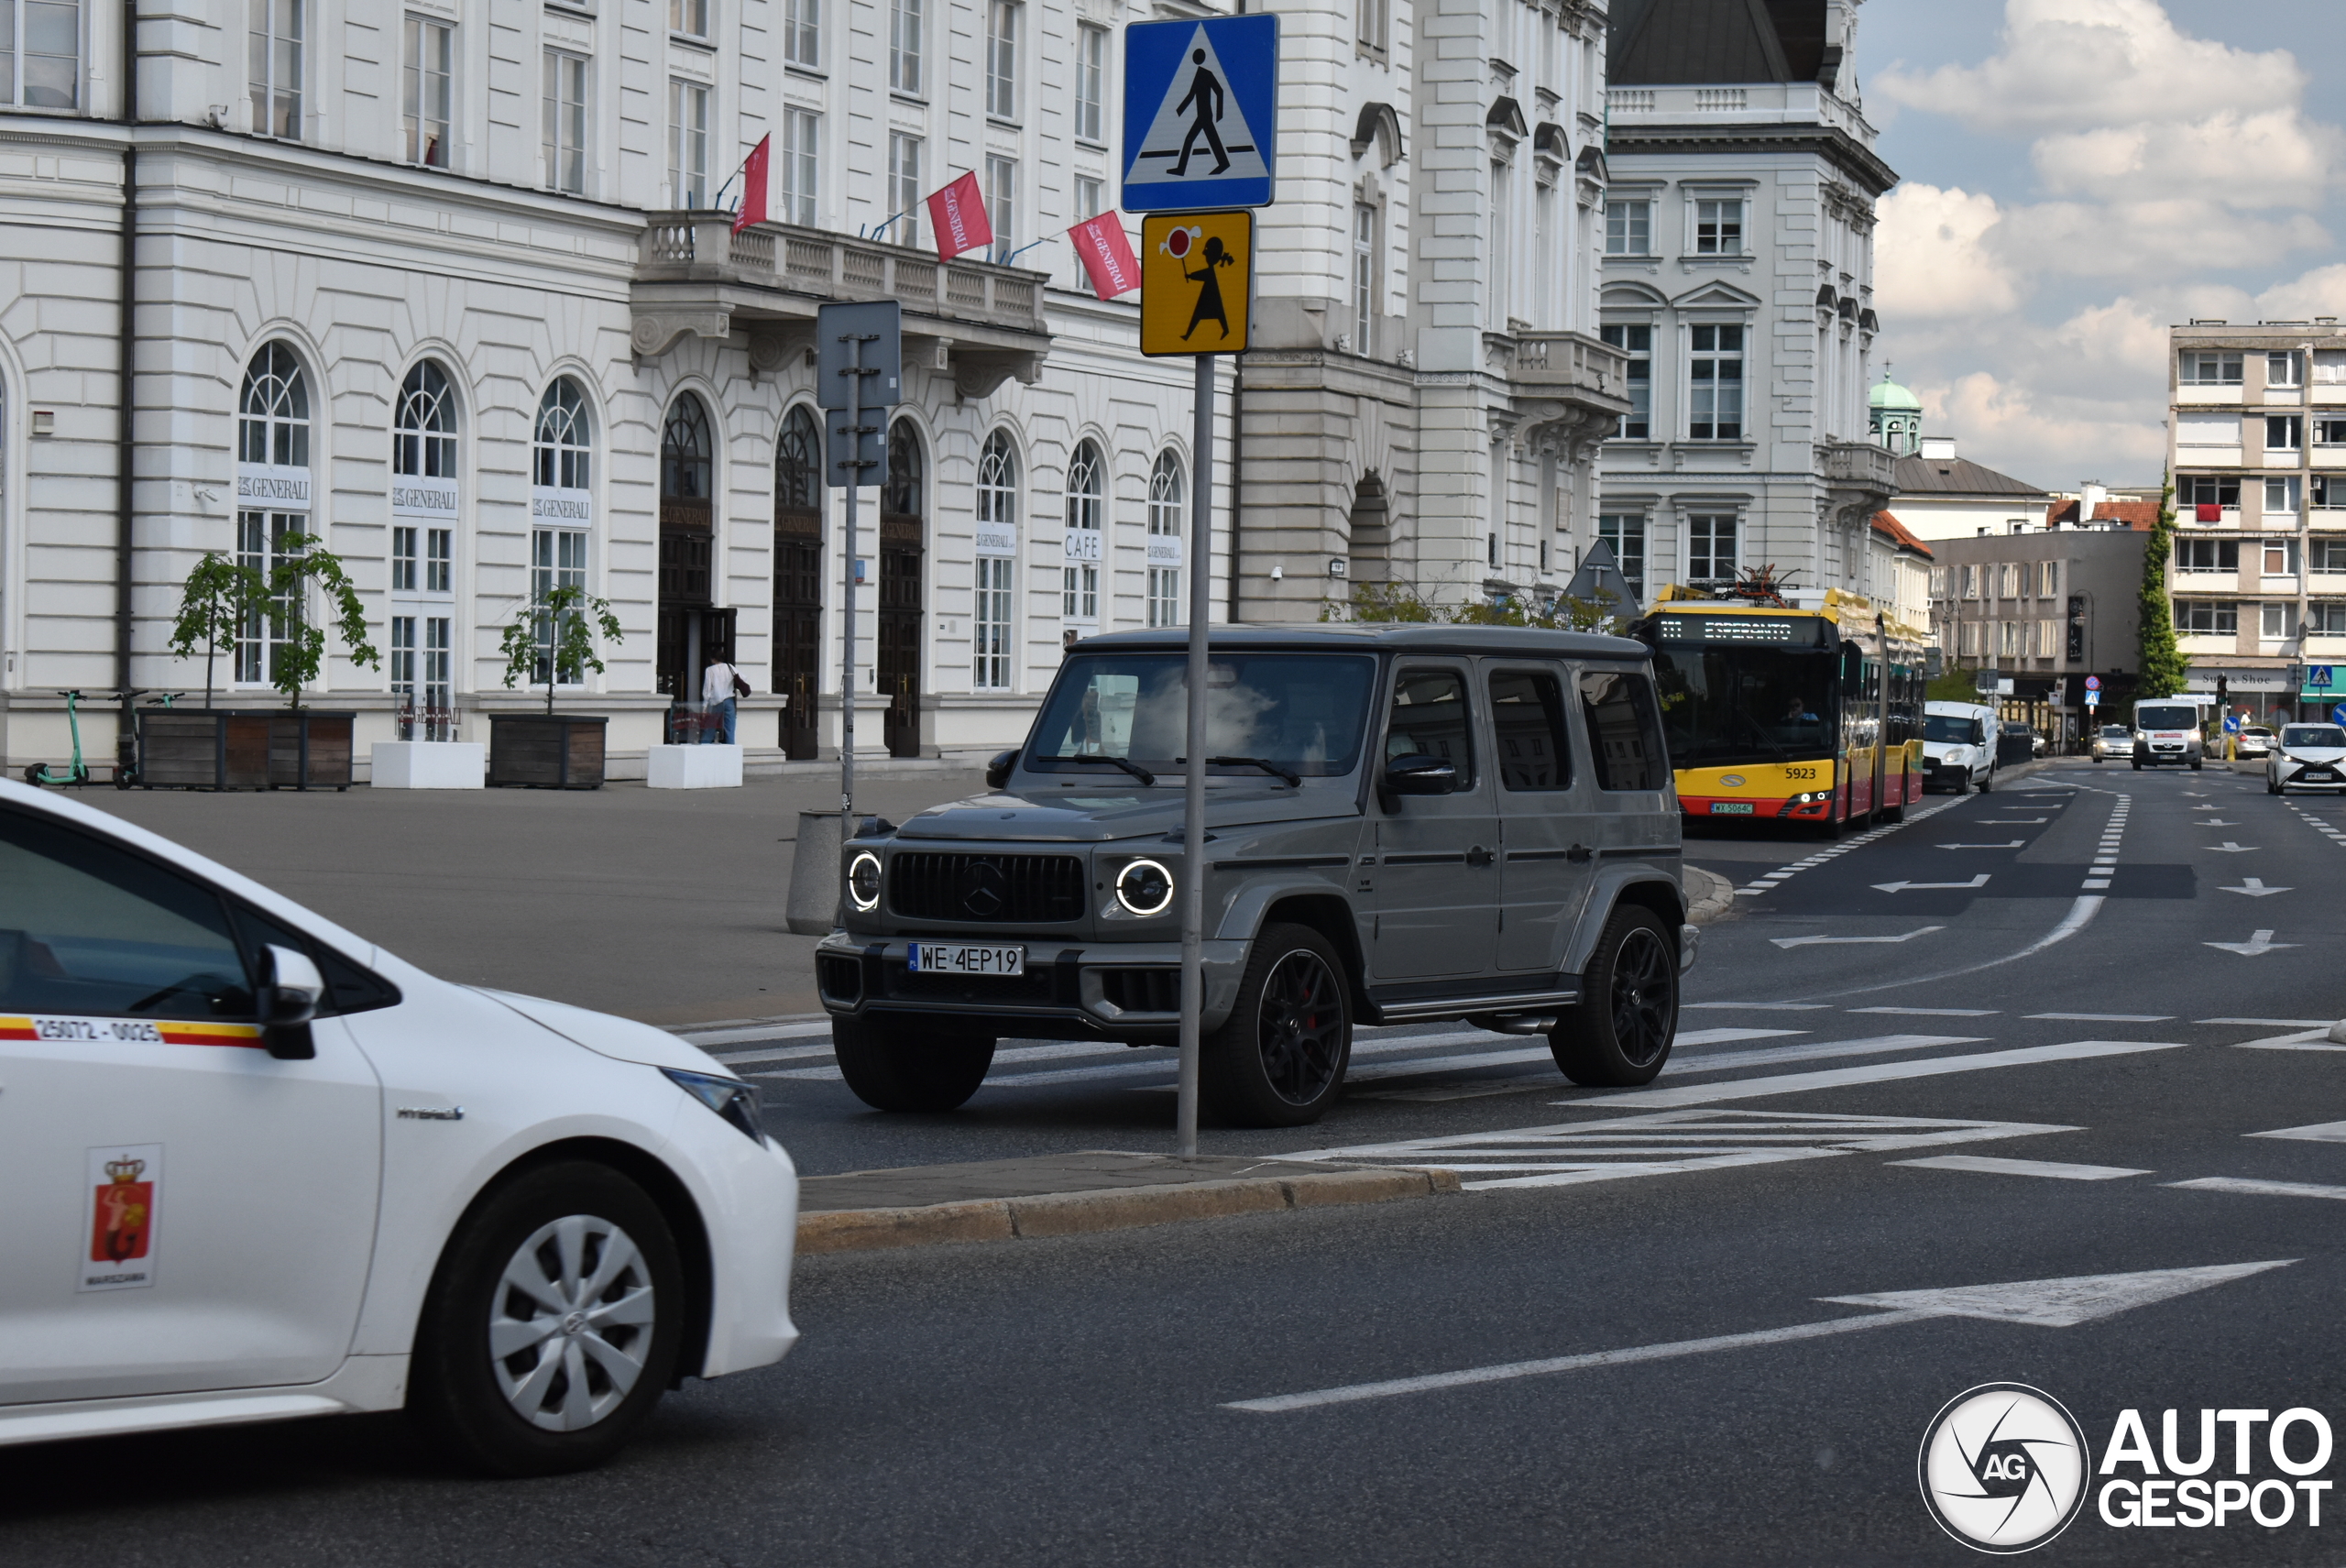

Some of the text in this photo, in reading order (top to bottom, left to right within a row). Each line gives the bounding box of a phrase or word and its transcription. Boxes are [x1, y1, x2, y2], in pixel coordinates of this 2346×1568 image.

[946, 199, 969, 250] GENERALI
[1094, 237, 1128, 291] GENERALI
[252, 477, 309, 500] GENERALI
[405, 488, 456, 510] GENERALI
[543, 499, 589, 520] GENERALI
[669, 506, 711, 526] GENERALI
[782, 514, 820, 533] GENERALI
[886, 522, 921, 540] GENERALI
[981, 533, 1008, 548] GENERALI
[1065, 534, 1097, 558] CAFE
[1152, 546, 1175, 559] GENERALI
[2242, 674, 2271, 685] Shoe
[413, 705, 462, 725] GENERALI
[1785, 768, 1816, 779] 5923
[1716, 804, 1751, 813] WX 5064C
[909, 947, 1017, 972] PL WE 4EP19
